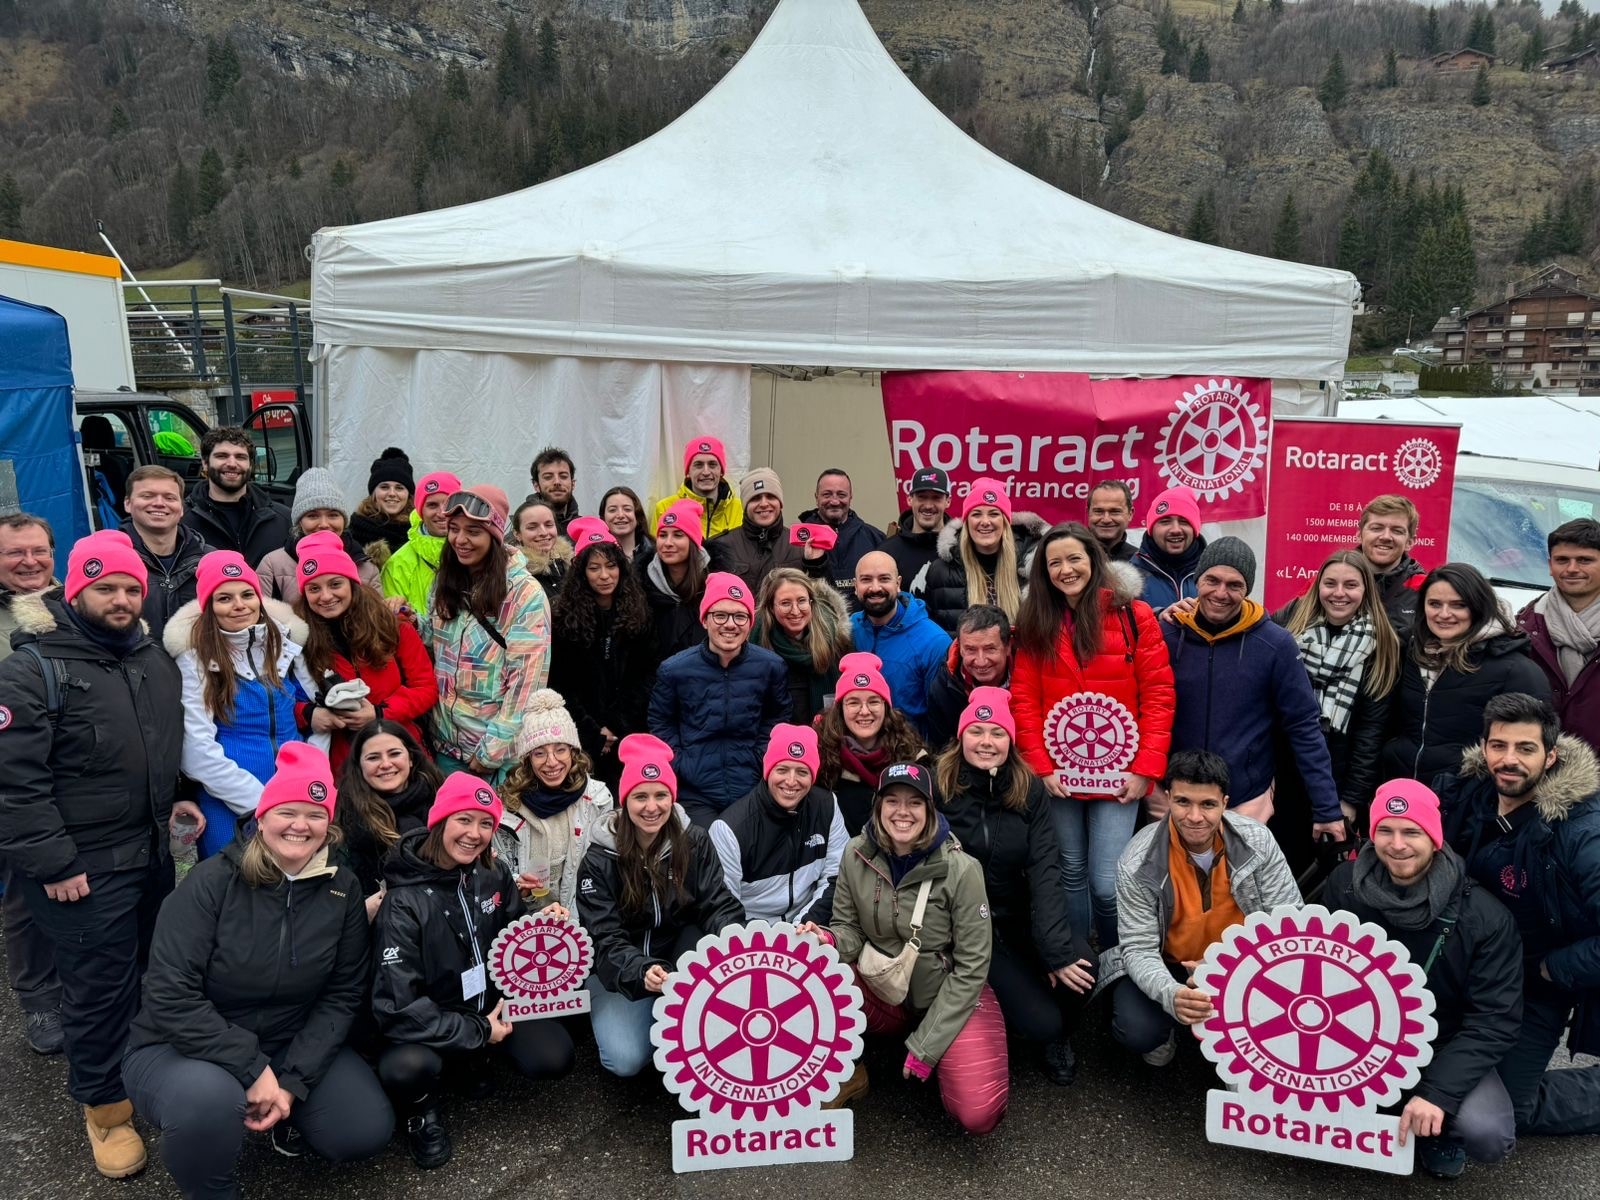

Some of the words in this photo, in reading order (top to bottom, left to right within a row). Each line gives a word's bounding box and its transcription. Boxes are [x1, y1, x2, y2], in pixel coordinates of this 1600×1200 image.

[1193, 391, 1236, 409] ROTARY
[892, 419, 1145, 473] Rotaract
[1285, 446, 1388, 471] Rotaract
[1169, 456, 1253, 489] INTERNATIONAL
[1329, 502, 1341, 511] DE
[1344, 503, 1354, 511] 18
[1305, 518, 1325, 526] 1500
[1327, 519, 1360, 527] MEMBR
[1286, 533, 1301, 541] 140
[1303, 534, 1319, 542] 000
[1321, 535, 1359, 543] MEMBRE
[1413, 537, 1435, 546] NDE
[1072, 705, 1109, 715] ROTARY
[1062, 747, 1122, 766] INTERNATIONAL
[1060, 774, 1126, 789] Rotaract
[520, 926, 560, 940] ROTARY
[1268, 938, 1360, 964] ROTARY
[718, 953, 799, 978] ROTARY
[510, 967, 576, 991] INTERNATIONAL
[508, 997, 583, 1017] Rotaract
[1234, 1036, 1388, 1091] INTERNATIONAL
[694, 1052, 827, 1101] INTERNATIONAL
[686, 1122, 837, 1158] Rotaract
[1221, 1101, 1394, 1158] Rotaract
